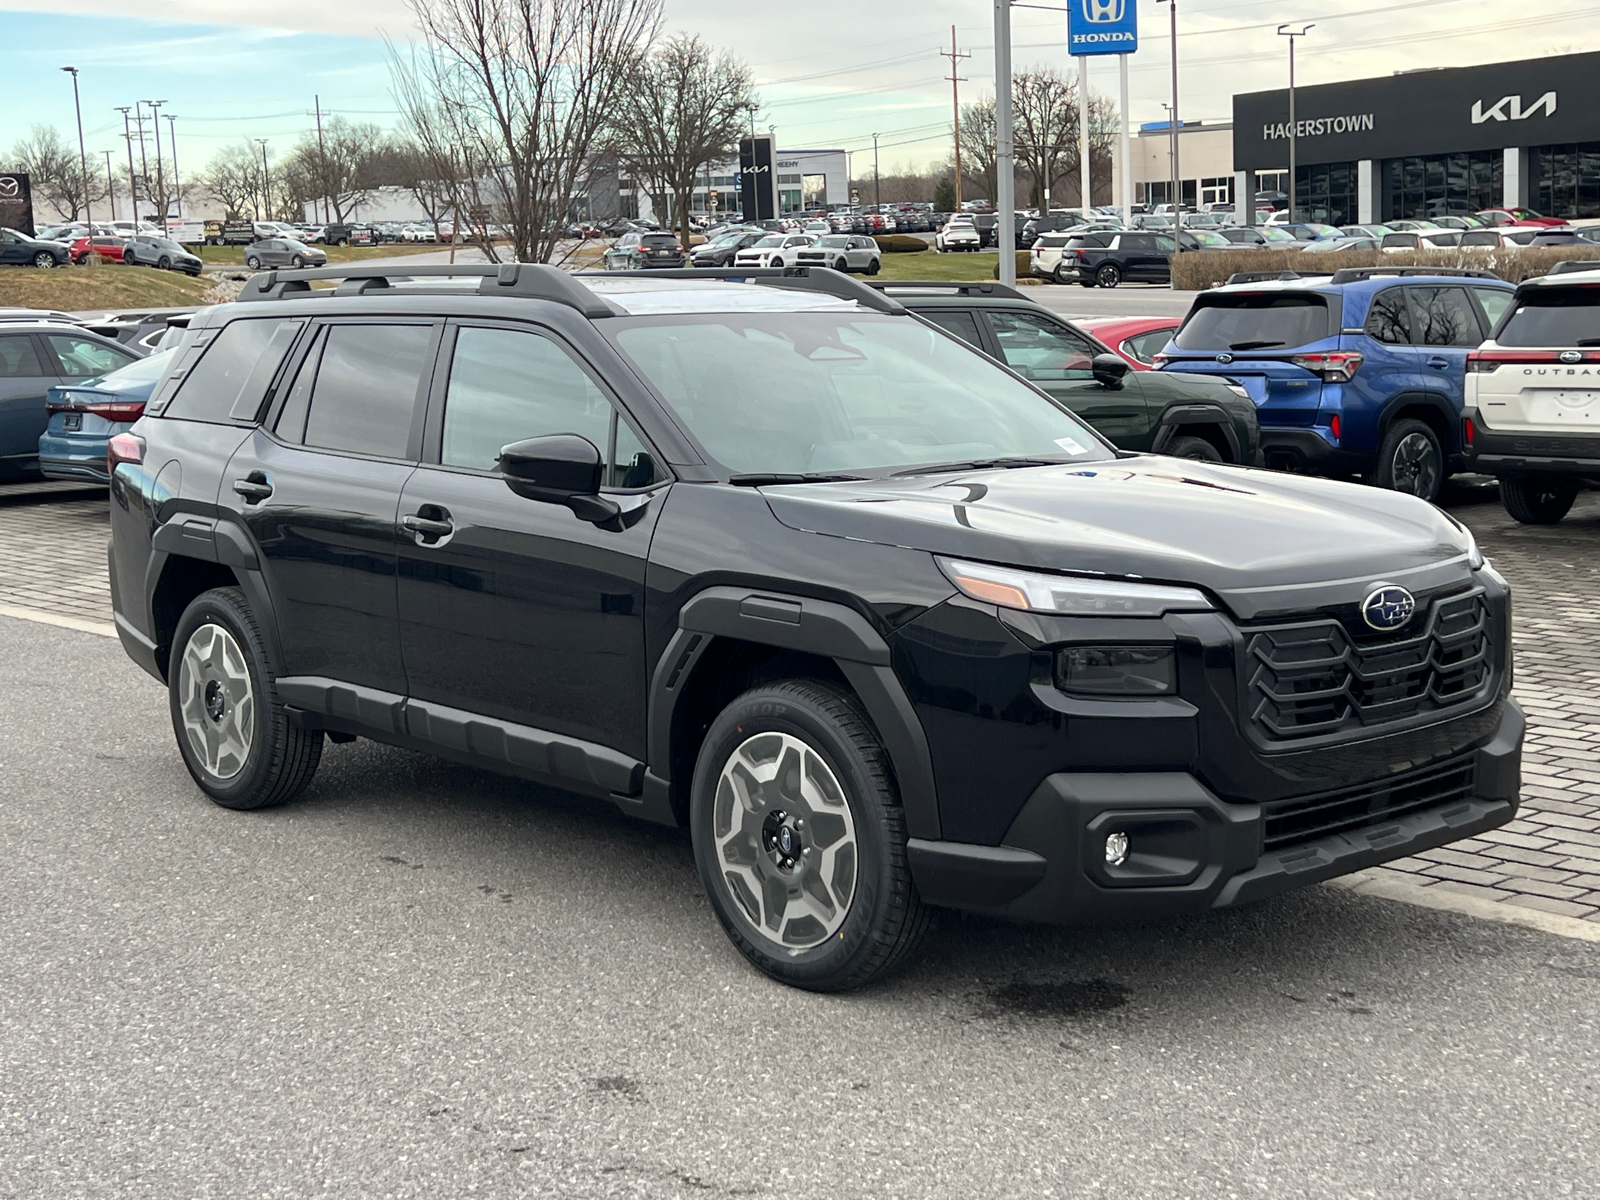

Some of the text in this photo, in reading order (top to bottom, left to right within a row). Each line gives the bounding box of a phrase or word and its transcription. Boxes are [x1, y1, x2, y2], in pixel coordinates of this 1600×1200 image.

[1073, 32, 1135, 43] HONDA
[1471, 91, 1557, 124] KIA
[1263, 113, 1374, 140] HAGERSTOWN
[743, 164, 769, 174] KIA
